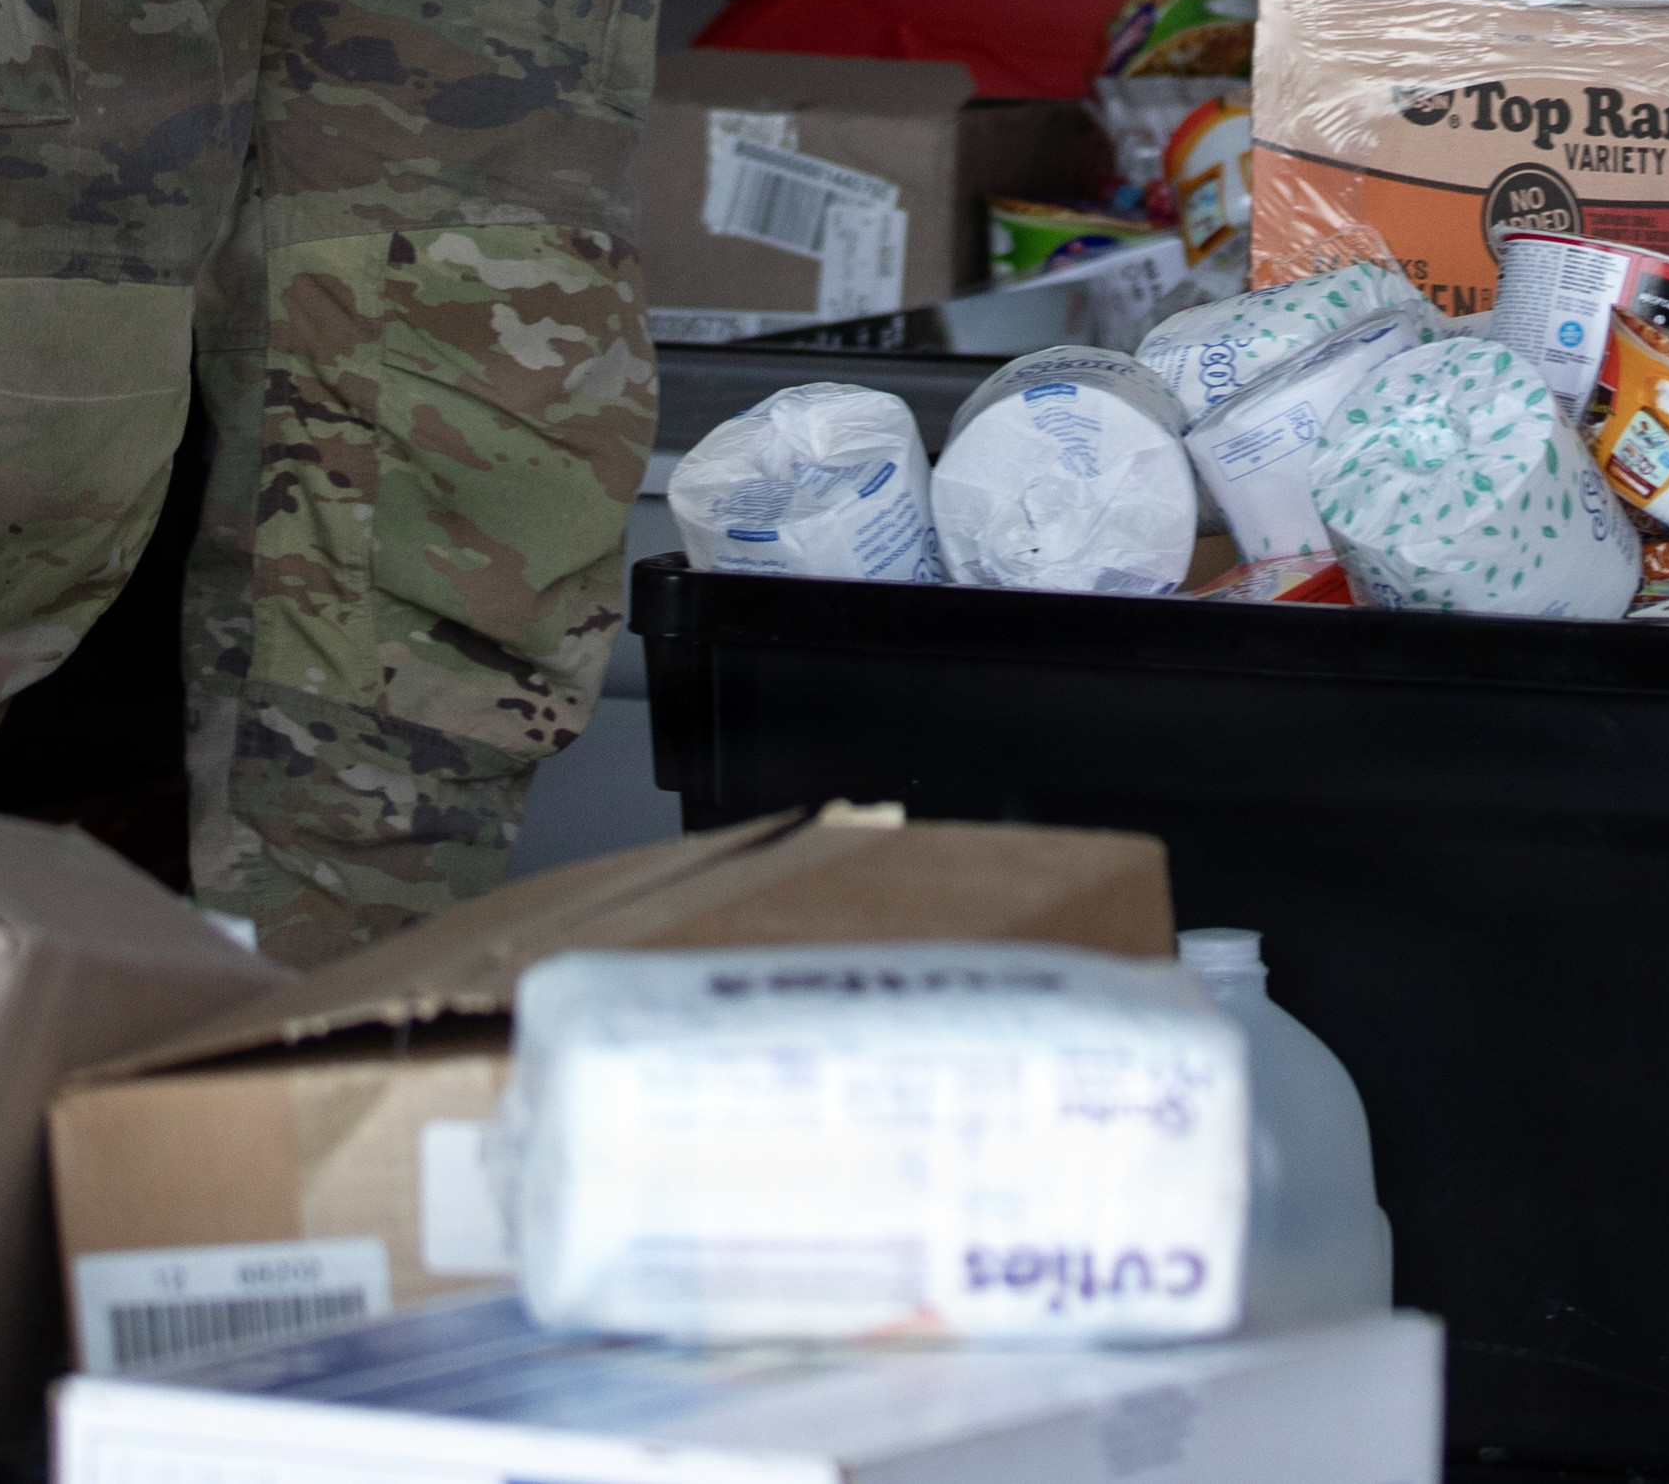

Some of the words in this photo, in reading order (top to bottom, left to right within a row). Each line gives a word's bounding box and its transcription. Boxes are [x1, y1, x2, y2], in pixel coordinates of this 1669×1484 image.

[1464, 79, 1573, 150] Top
[1563, 141, 1668, 177] VARIETY
[1510, 185, 1545, 212] NO
